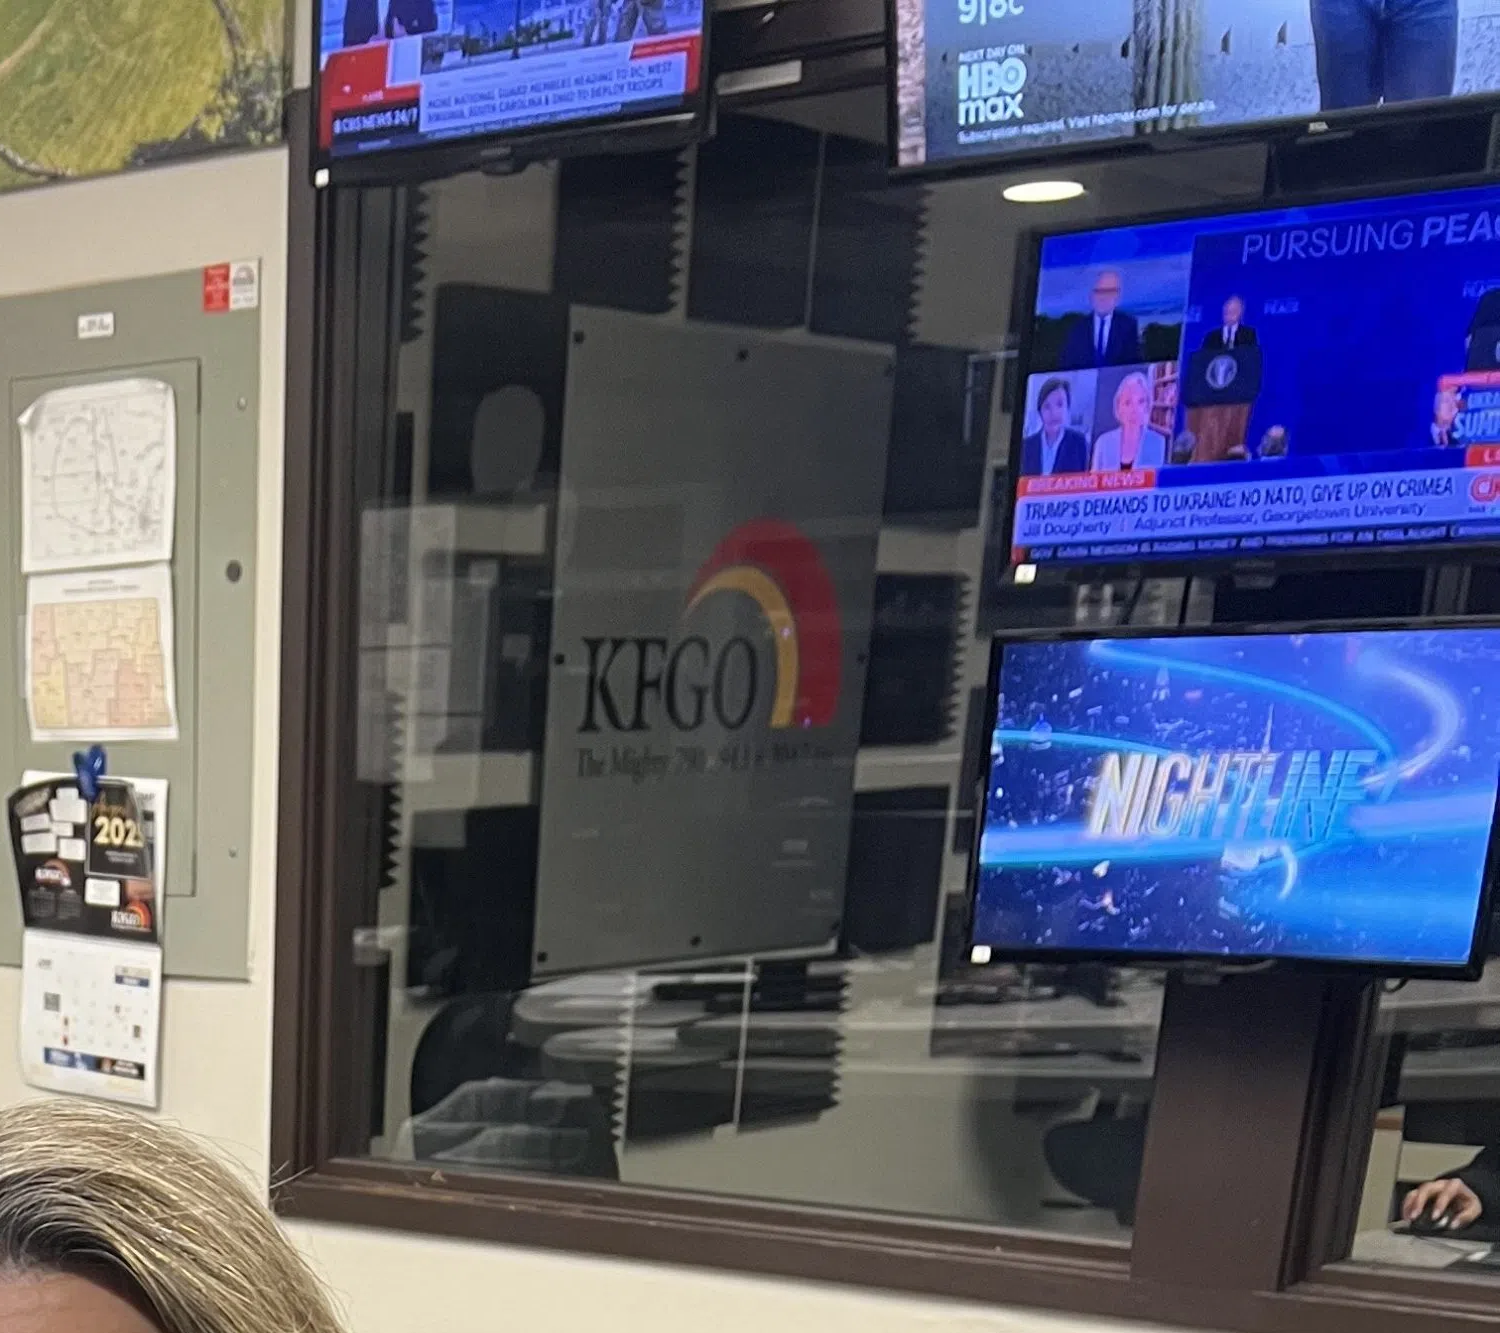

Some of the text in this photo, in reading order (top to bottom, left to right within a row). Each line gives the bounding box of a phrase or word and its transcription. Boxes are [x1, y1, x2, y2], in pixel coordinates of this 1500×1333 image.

[1007, 45, 1025, 56] ON
[958, 57, 1027, 100] HBO
[958, 93, 1025, 125] max
[1242, 219, 1414, 264] PURSUING
[1025, 500, 1080, 521] TRUMP'S
[1083, 495, 1148, 516] DEMANDS
[1153, 493, 1170, 513] TO
[1241, 489, 1261, 507] NO
[1265, 485, 1307, 507] NATO,
[1311, 483, 1345, 503] GIVE
[1348, 481, 1368, 500] UP
[1371, 478, 1394, 499] ON
[1396, 476, 1453, 497] CRIMEA
[1026, 471, 1145, 493] BREAKING NEWS
[1023, 502, 1426, 538] Jill Dougherty Adjunct Professor, Georgetown University
[577, 635, 758, 734] KFGO
[1088, 747, 1380, 841] NIGHTLINE
[93, 816, 145, 848] 202
